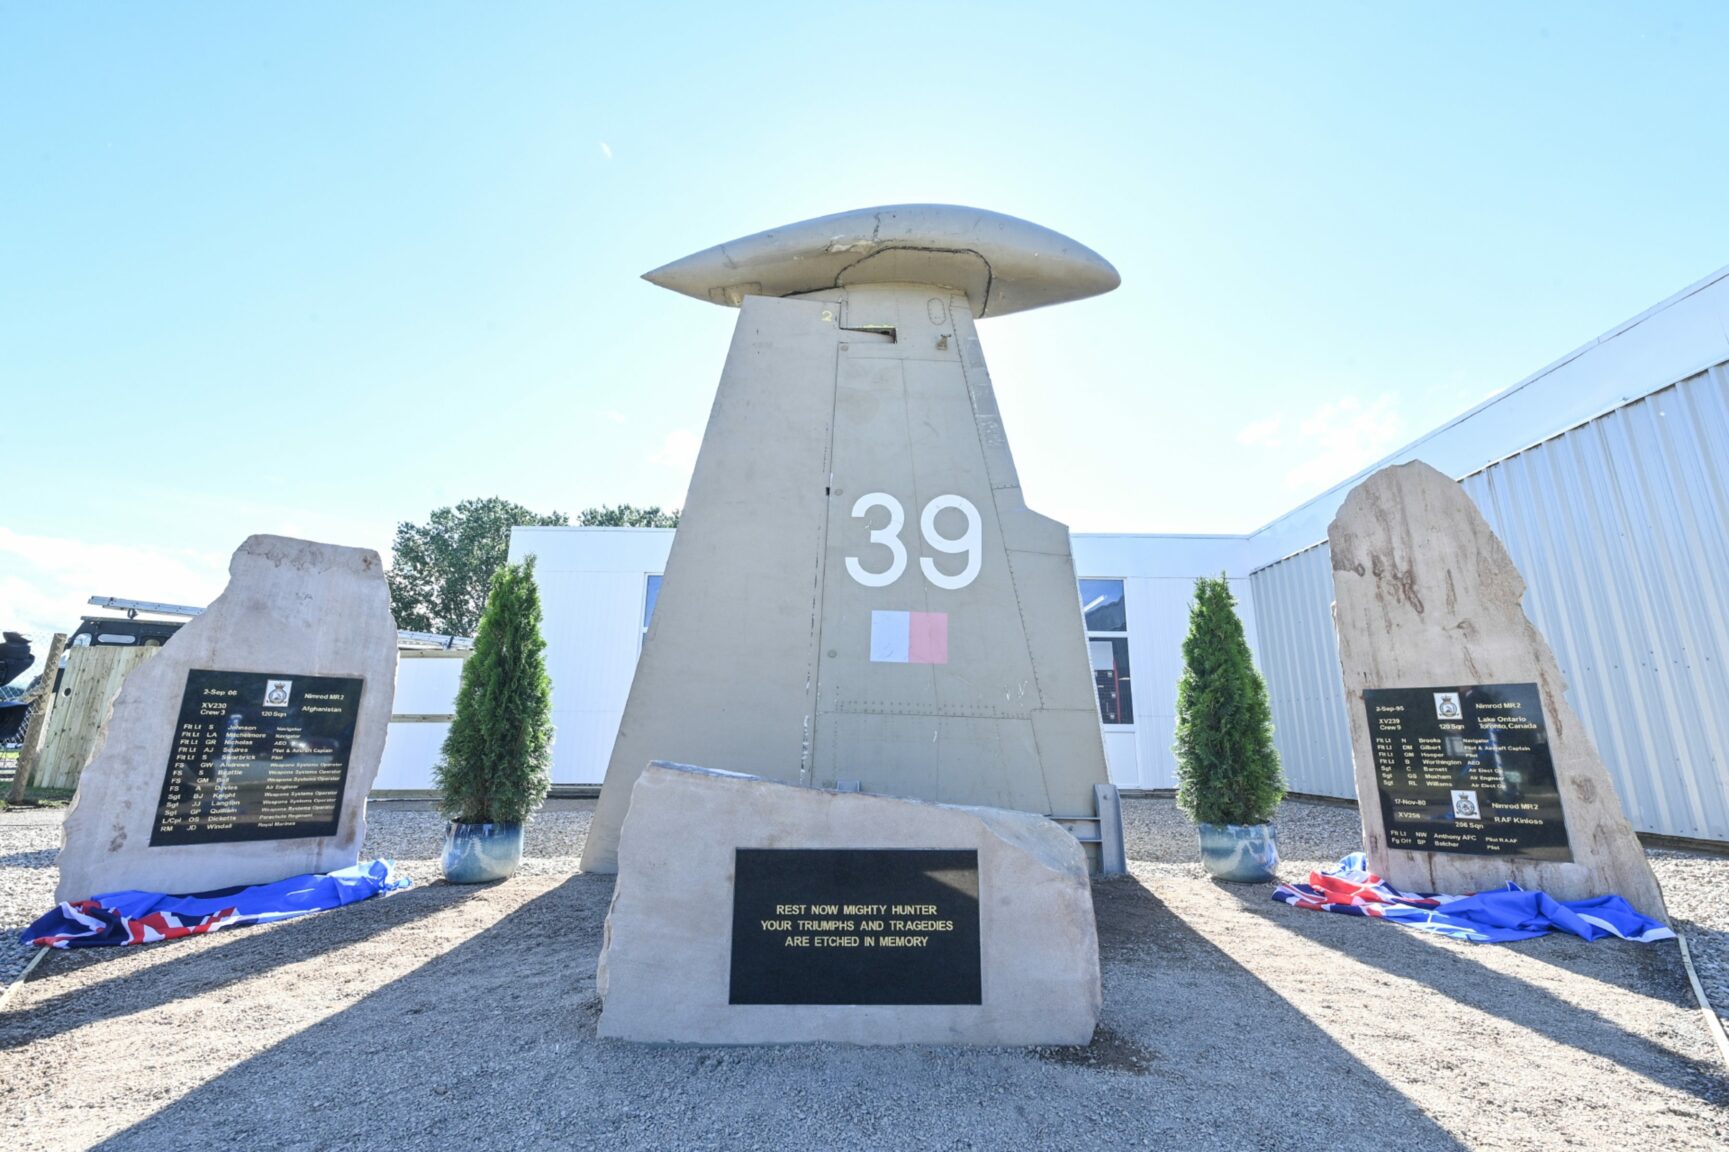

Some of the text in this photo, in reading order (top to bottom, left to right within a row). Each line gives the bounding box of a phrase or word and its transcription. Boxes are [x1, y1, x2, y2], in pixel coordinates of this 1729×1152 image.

[822, 310, 832, 321] 2
[845, 492, 982, 589] 39
[776, 904, 937, 915] REST NOW MIGHTY HUNTER
[761, 921, 954, 931] YOUR TRIUMPHS AND TRAGEDIES
[785, 936, 928, 947] ARE ETCHED IN MEMORY
